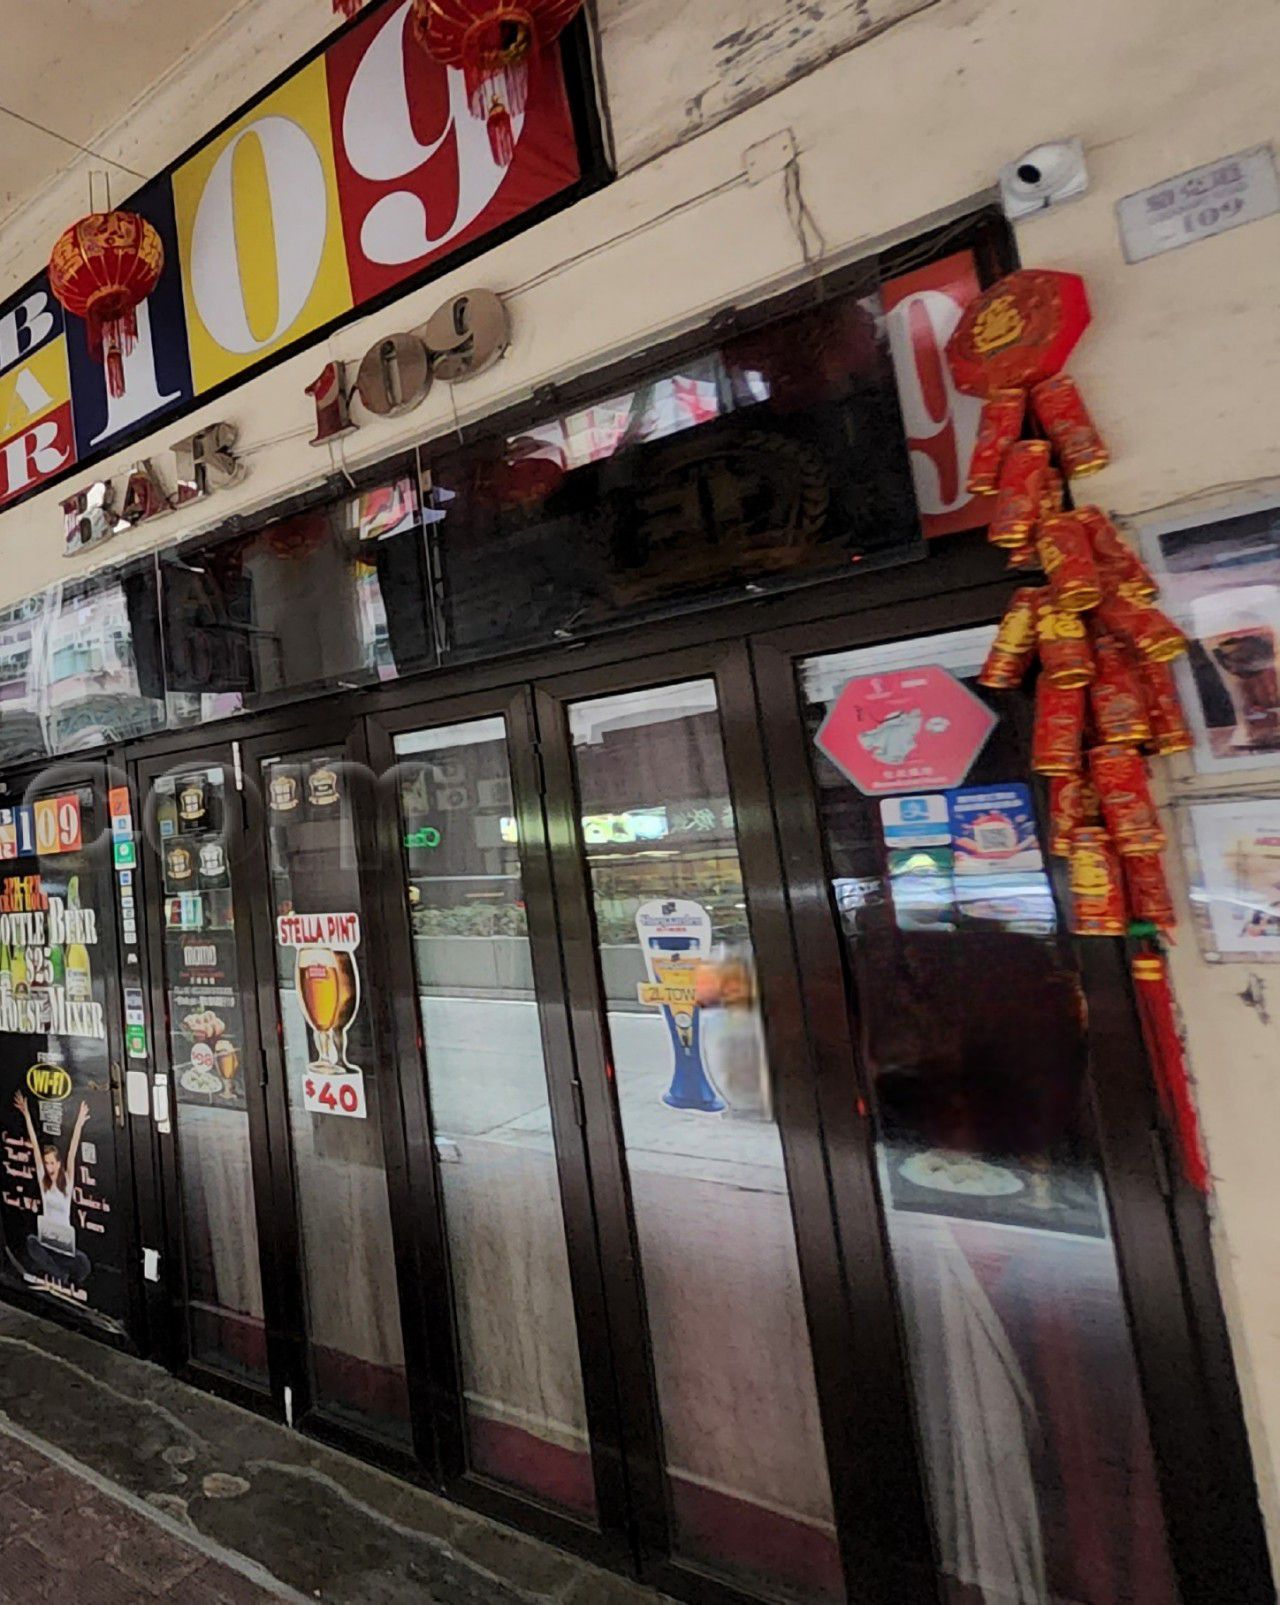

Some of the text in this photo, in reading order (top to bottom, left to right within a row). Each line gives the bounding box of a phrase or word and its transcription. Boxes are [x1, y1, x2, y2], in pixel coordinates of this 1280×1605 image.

[305, 287, 512, 447] 109
[59, 421, 249, 558] BAR
[20, 803, 79, 851] 109
[281, 914, 357, 944] STELLA PINT
[664, 986, 696, 1001] TOW
[305, 1078, 358, 1112] $40
